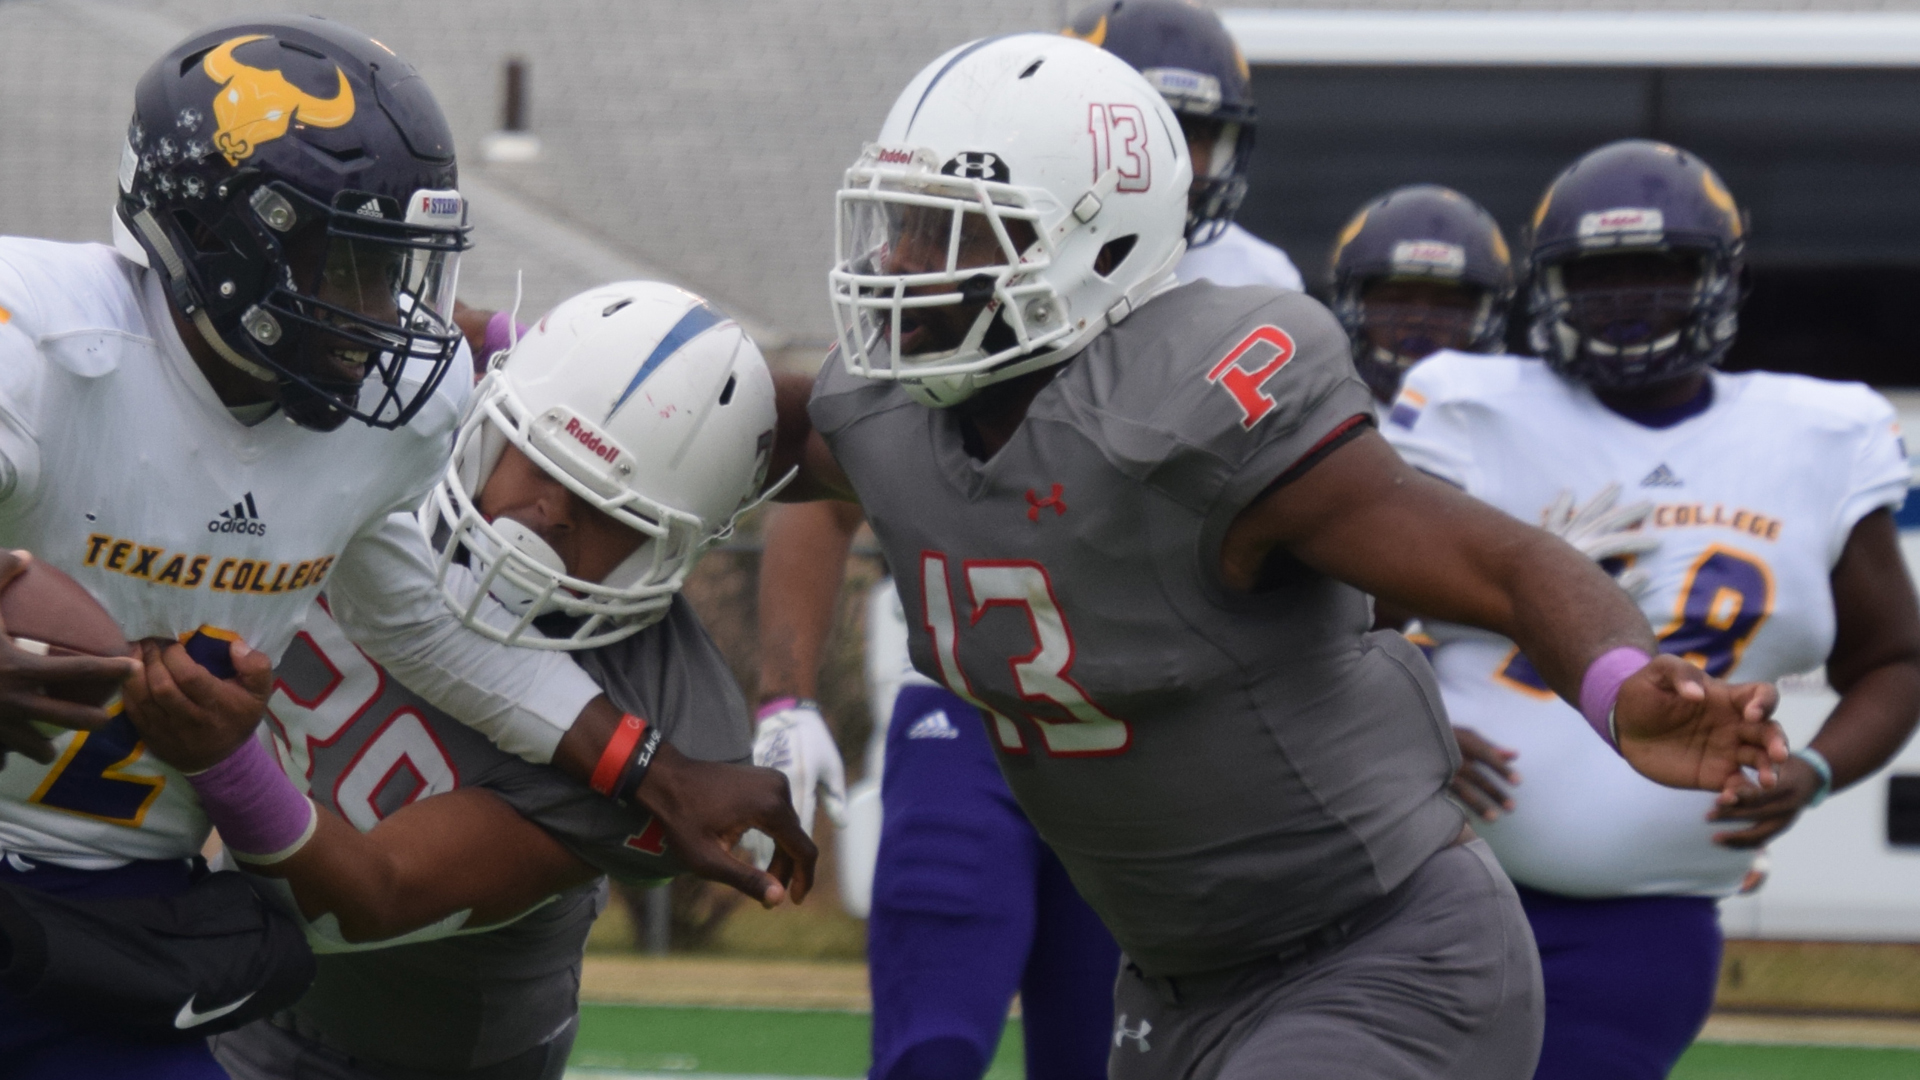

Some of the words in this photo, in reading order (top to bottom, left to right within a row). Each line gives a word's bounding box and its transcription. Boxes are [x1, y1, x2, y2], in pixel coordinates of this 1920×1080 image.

[1088, 103, 1152, 194] 13
[1206, 323, 1297, 434] P
[564, 416, 621, 465] Riddell
[207, 517, 267, 537] adidas
[1654, 504, 1783, 542] COLLEGE
[84, 532, 211, 589] TEXAS
[209, 554, 337, 596] COLLEGE
[919, 548, 1134, 759] 13
